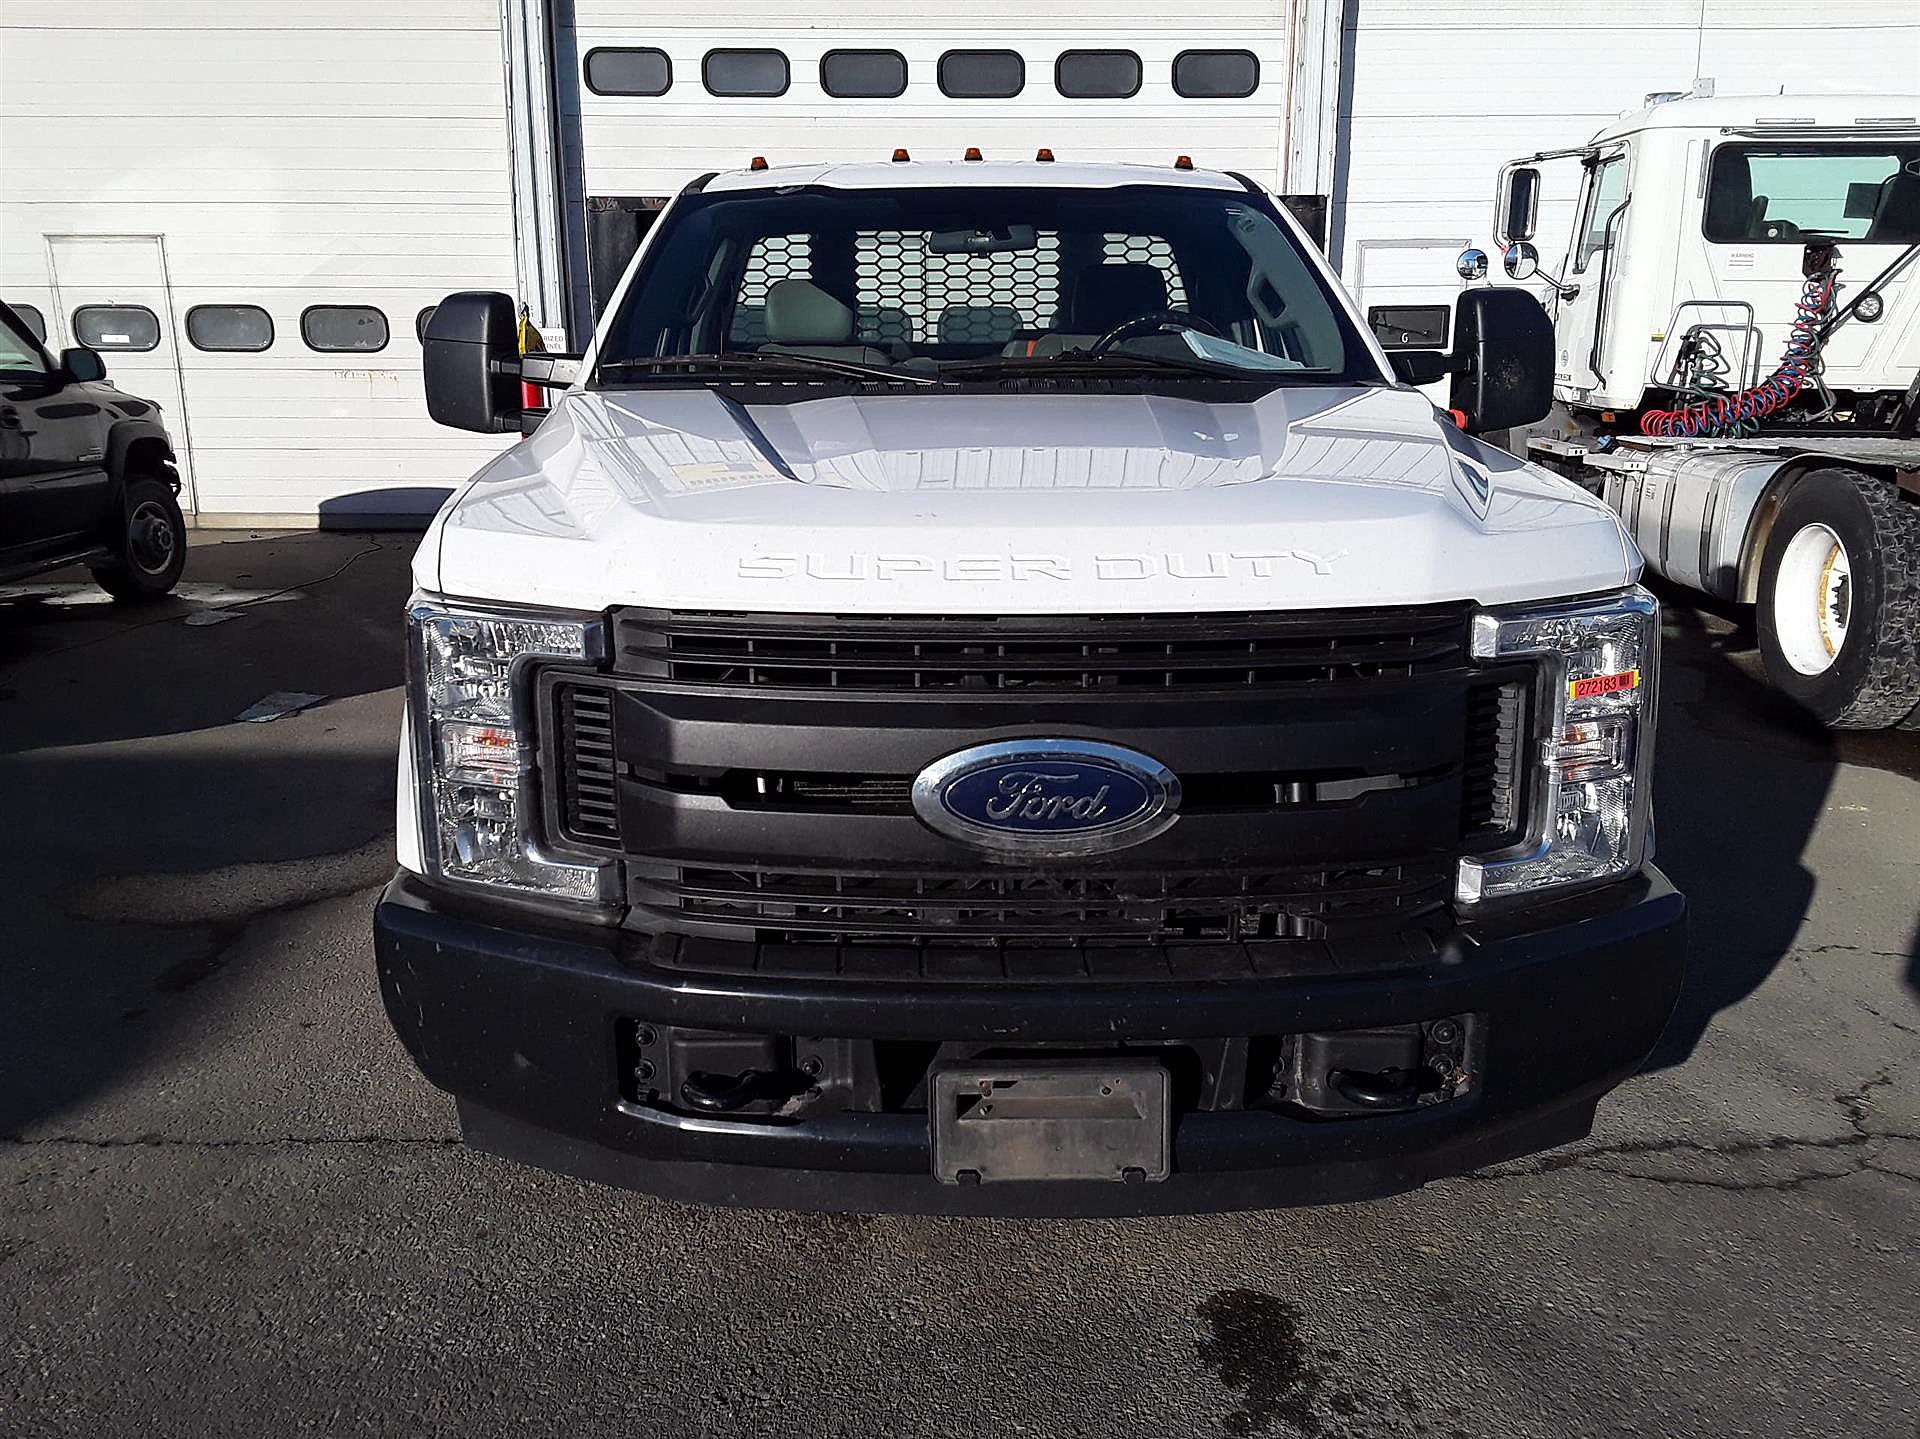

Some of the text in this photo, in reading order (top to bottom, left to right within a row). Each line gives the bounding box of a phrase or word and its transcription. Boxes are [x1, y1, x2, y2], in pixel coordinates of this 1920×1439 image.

[738, 549, 1348, 582] SUPER DUTY
[1578, 677, 1617, 696] 272183
[986, 771, 1110, 821] Ford
